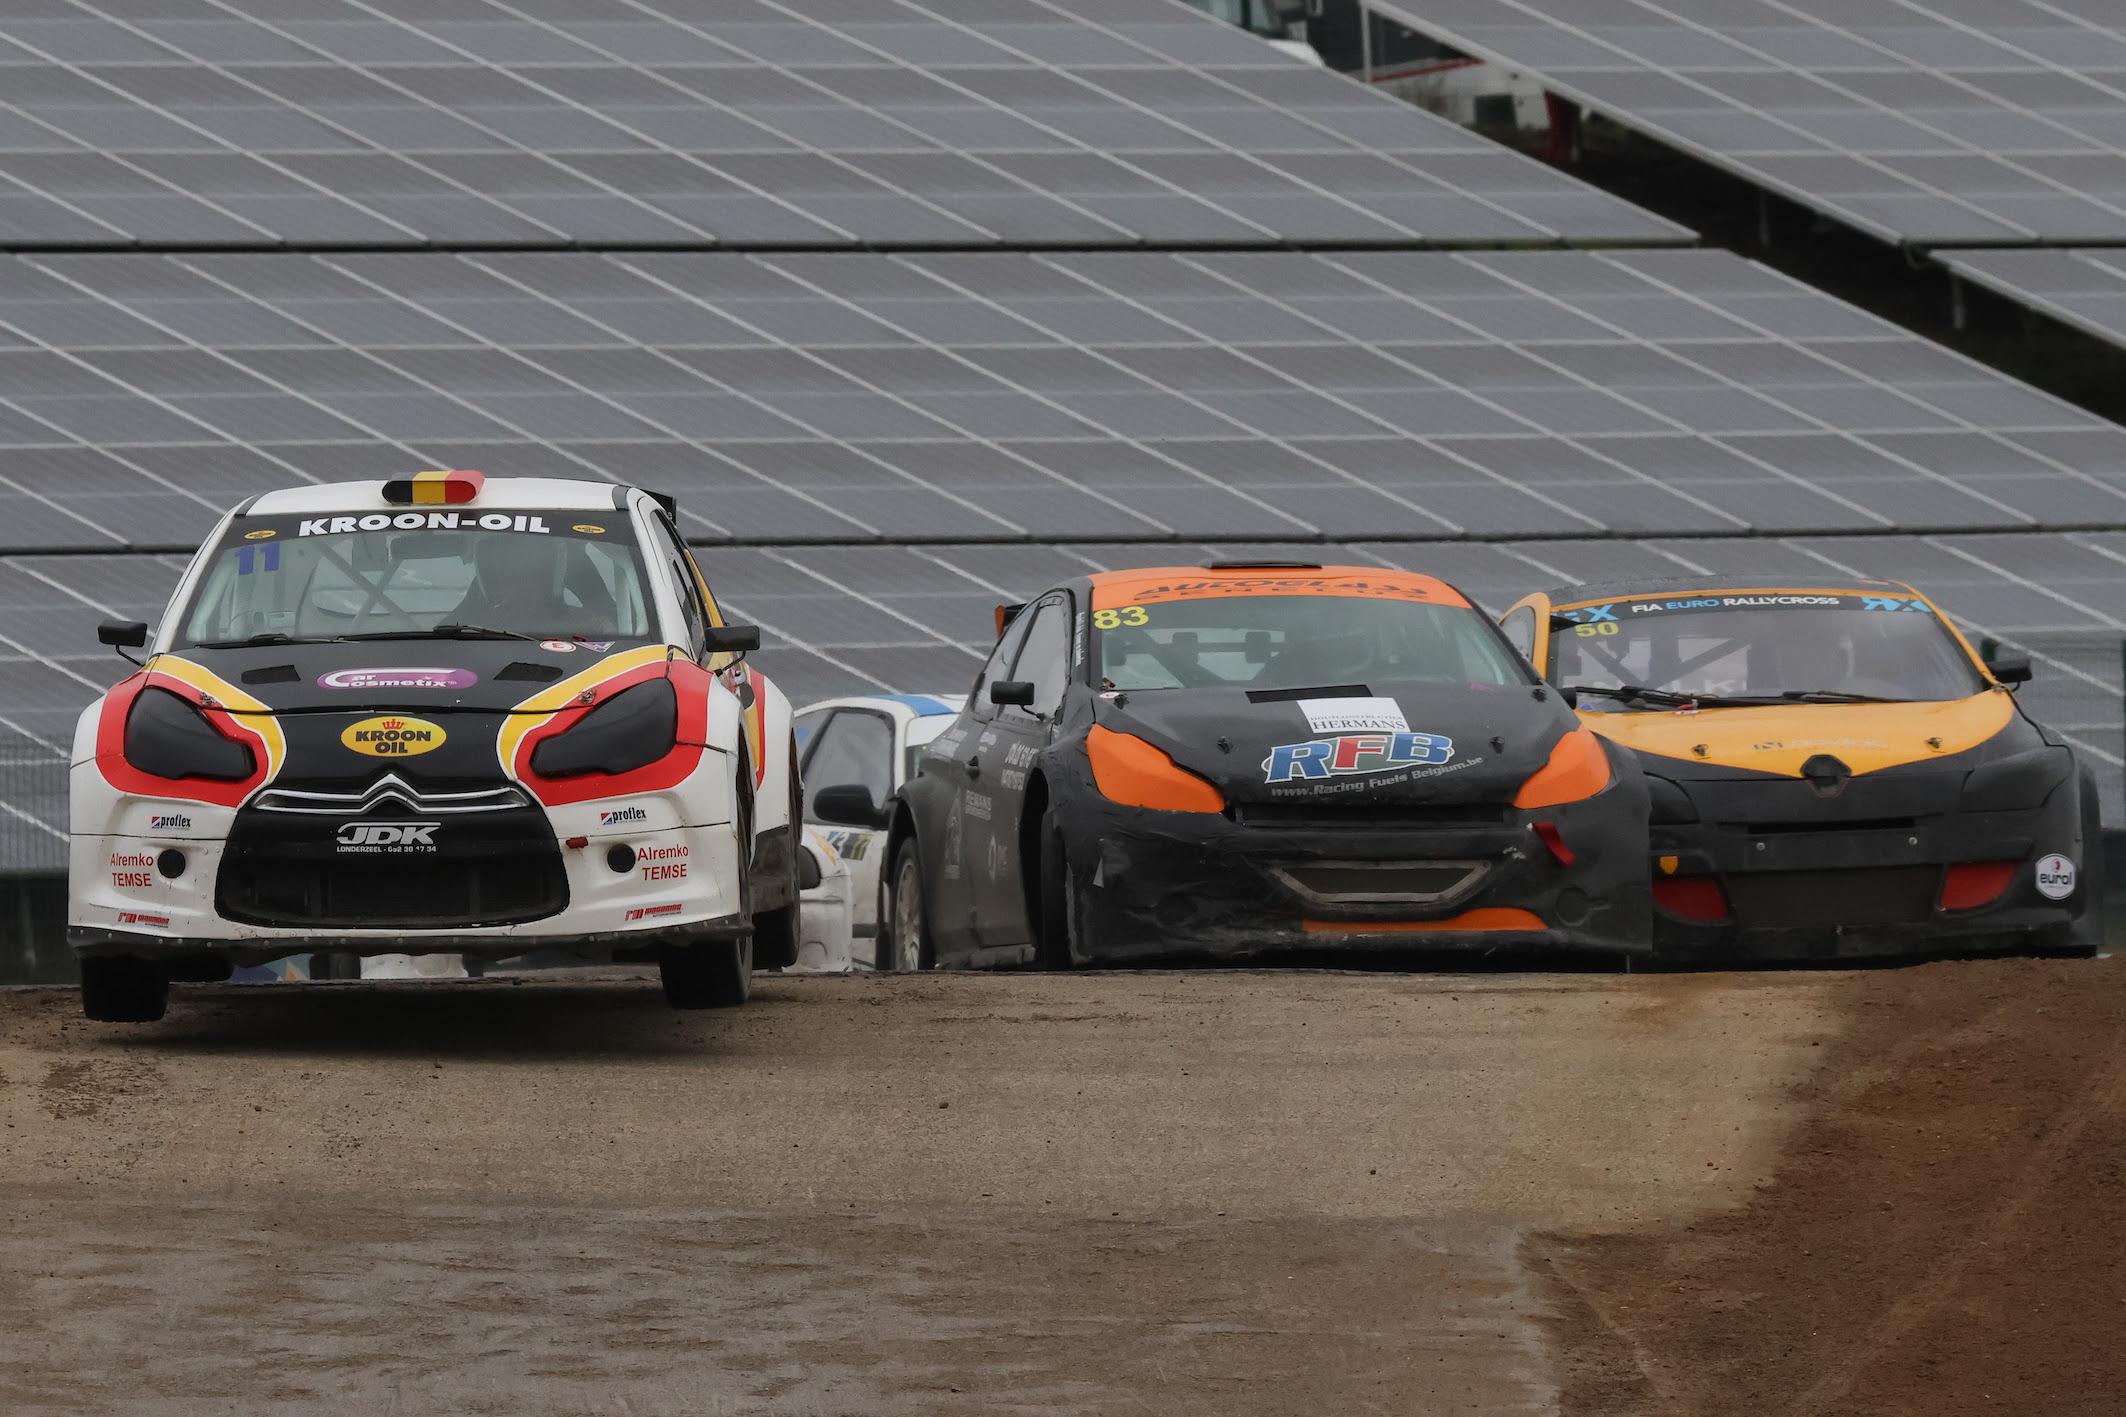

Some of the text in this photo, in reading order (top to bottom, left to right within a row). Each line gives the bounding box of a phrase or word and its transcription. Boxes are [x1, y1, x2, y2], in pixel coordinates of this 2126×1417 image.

[299, 513, 550, 536] KROON-OIL
[235, 541, 280, 575] 11
[1631, 596, 1840, 613] FIA EURO RALLYCROSS
[1093, 606, 1149, 630] 83
[1575, 622, 1619, 637] 50
[1312, 719, 1405, 730] HERMANS
[355, 730, 431, 742] KROON
[374, 742, 408, 754] OIL
[1264, 733, 1453, 784] RFB
[1271, 755, 1483, 797] www.Racing Fuels Belgium.be
[160, 814, 191, 829] proflex
[612, 806, 647, 824] proflex
[336, 821, 441, 845] JDK
[336, 845, 382, 853] LONDERZEEL
[637, 844, 689, 861] Alremko
[110, 852, 154, 867] Alremko
[112, 872, 152, 887] TEMSE
[642, 863, 687, 881] TEMSE
[2040, 871, 2072, 885] eurol
